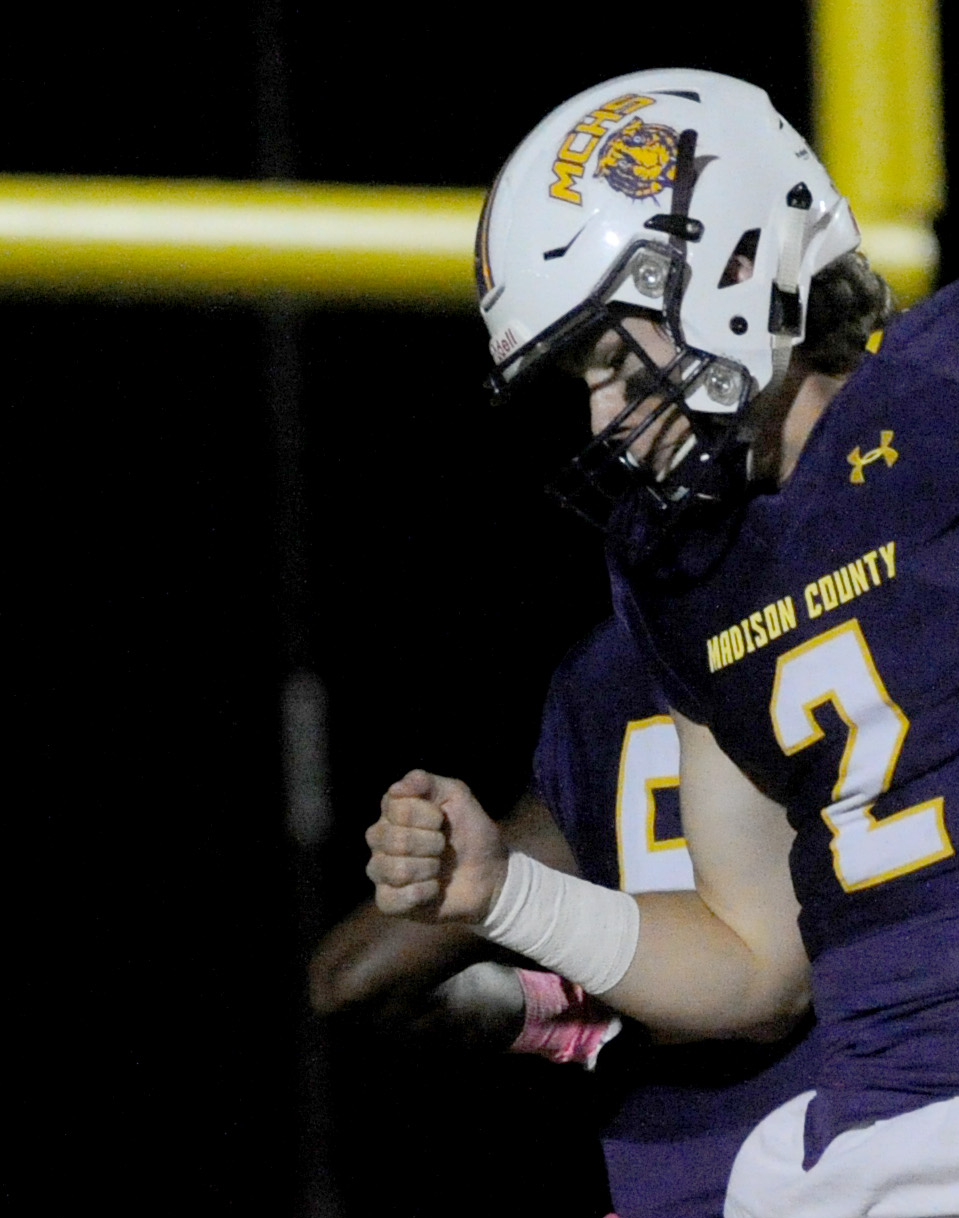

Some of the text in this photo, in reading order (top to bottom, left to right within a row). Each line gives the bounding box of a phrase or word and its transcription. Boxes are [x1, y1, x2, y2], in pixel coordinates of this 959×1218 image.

[549, 94, 656, 206] MCHS
[707, 541, 896, 673] MADISON COUNTY
[769, 617, 955, 894] 2
